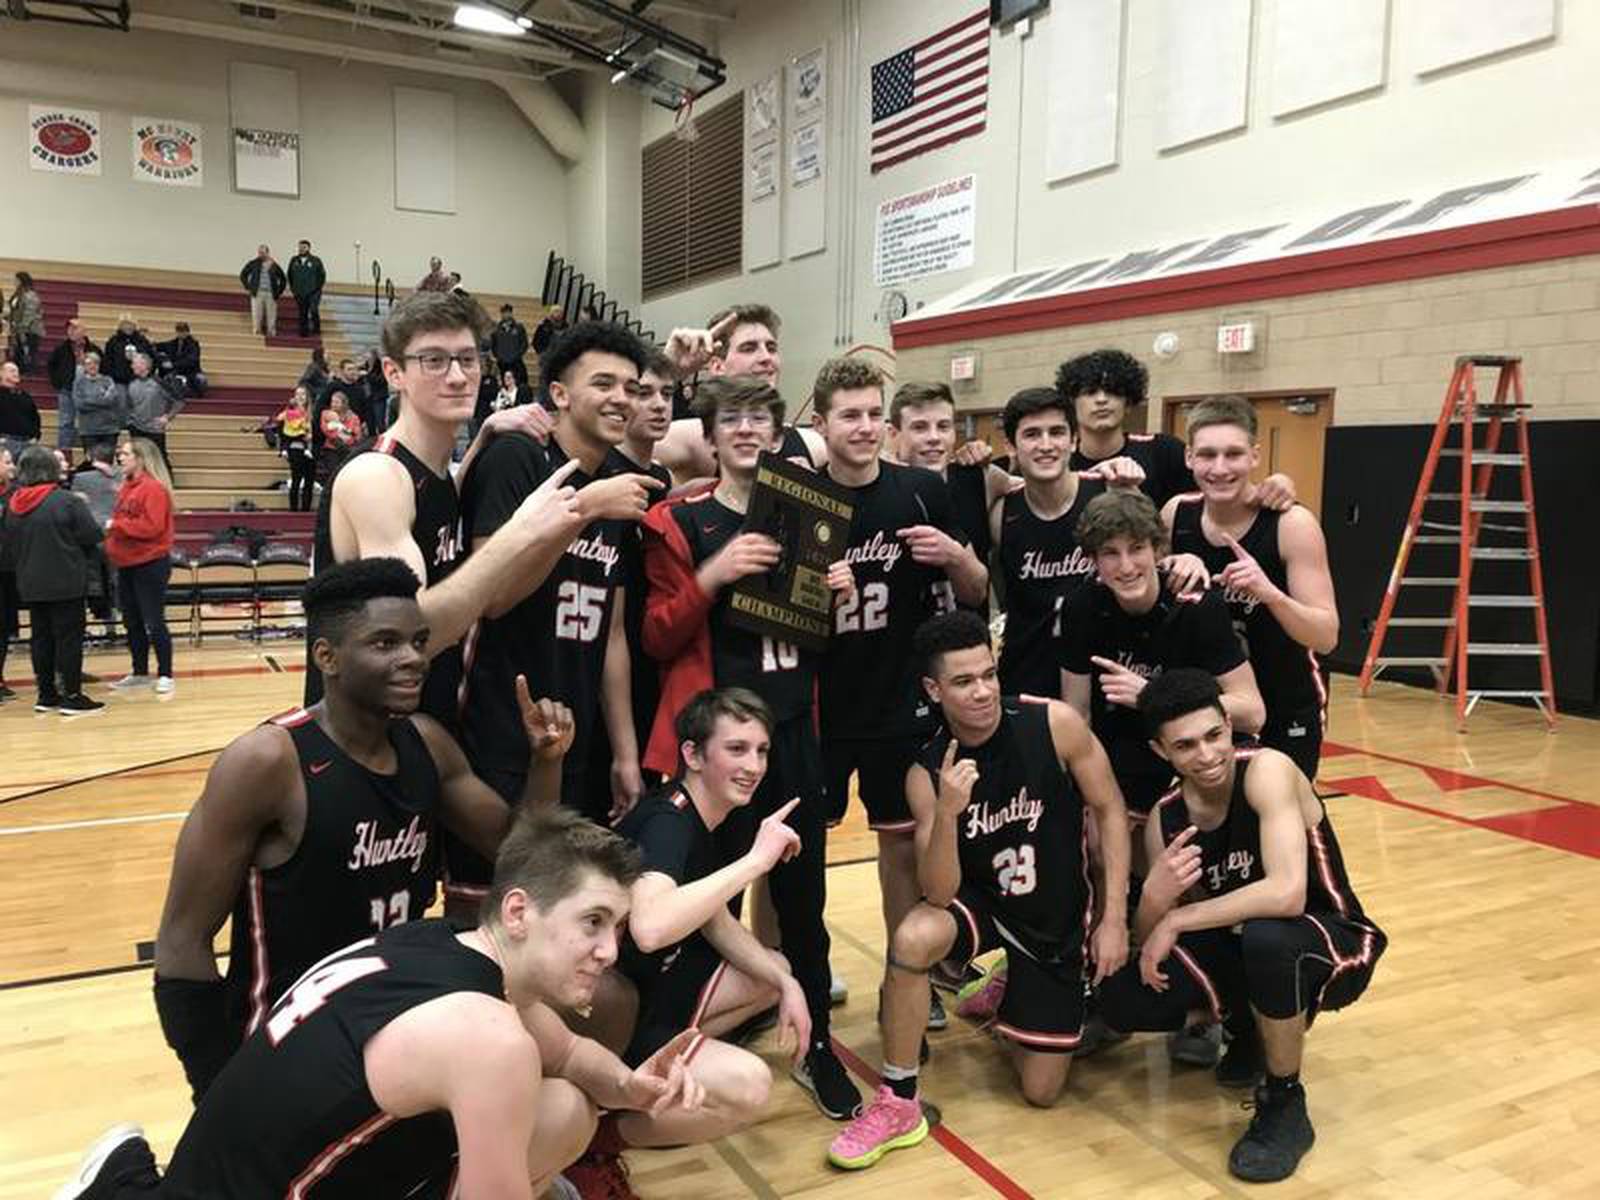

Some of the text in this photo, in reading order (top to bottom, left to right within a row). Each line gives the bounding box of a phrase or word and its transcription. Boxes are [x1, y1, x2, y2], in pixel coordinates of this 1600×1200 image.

[556, 580, 607, 641] 25
[834, 582, 889, 634] 22
[965, 786, 1044, 839] Huntley
[348, 815, 428, 873] Huntley
[992, 844, 1037, 896] 23
